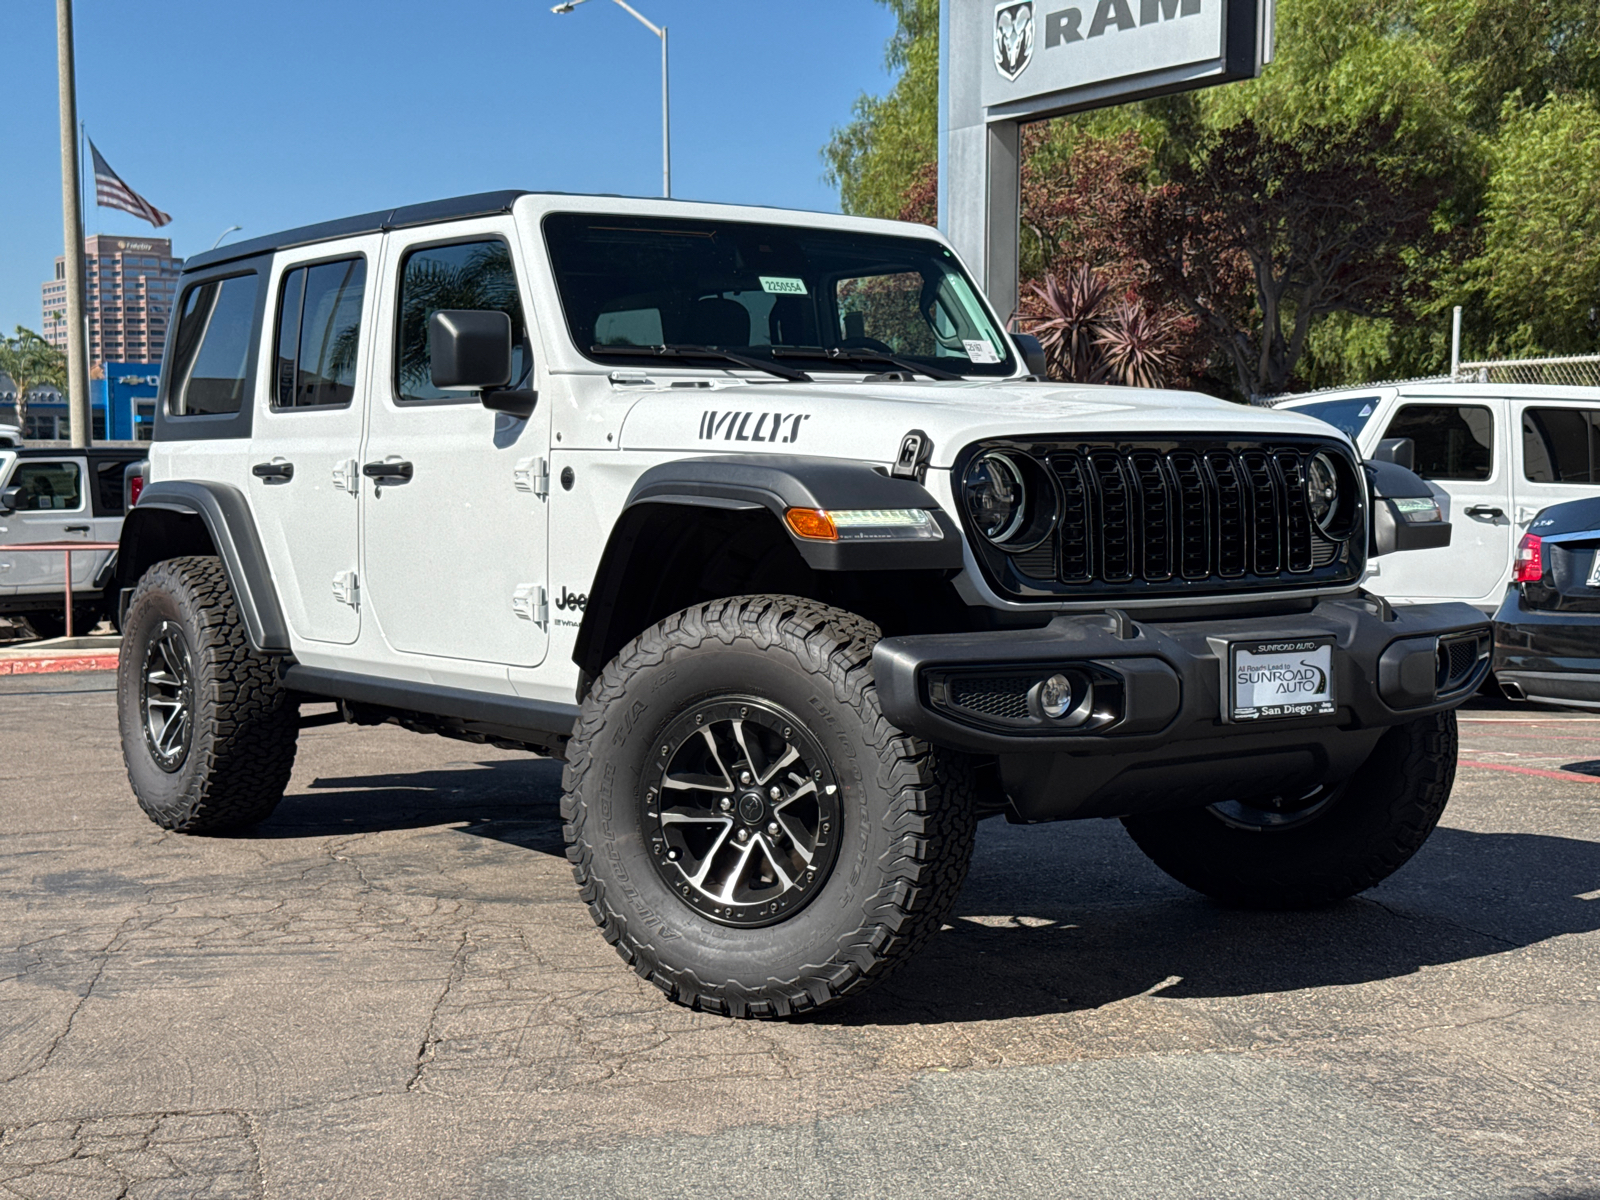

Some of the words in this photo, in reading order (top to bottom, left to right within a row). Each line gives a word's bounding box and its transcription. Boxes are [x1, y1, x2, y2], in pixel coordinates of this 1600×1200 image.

[1045, 0, 1201, 50] RAM
[765, 281, 802, 292] 2250554
[699, 411, 811, 443] WILLYS
[555, 586, 588, 612] Jee
[1258, 643, 1295, 652] SUNROAD
[1296, 642, 1315, 650] AUTO
[1238, 665, 1246, 673] All
[1247, 664, 1267, 672] Roads
[1268, 663, 1283, 671] Lead
[1238, 669, 1315, 684] SUNROAD
[1276, 680, 1315, 694] AUTO
[1261, 706, 1281, 716] San
[1284, 704, 1313, 716] Diego
